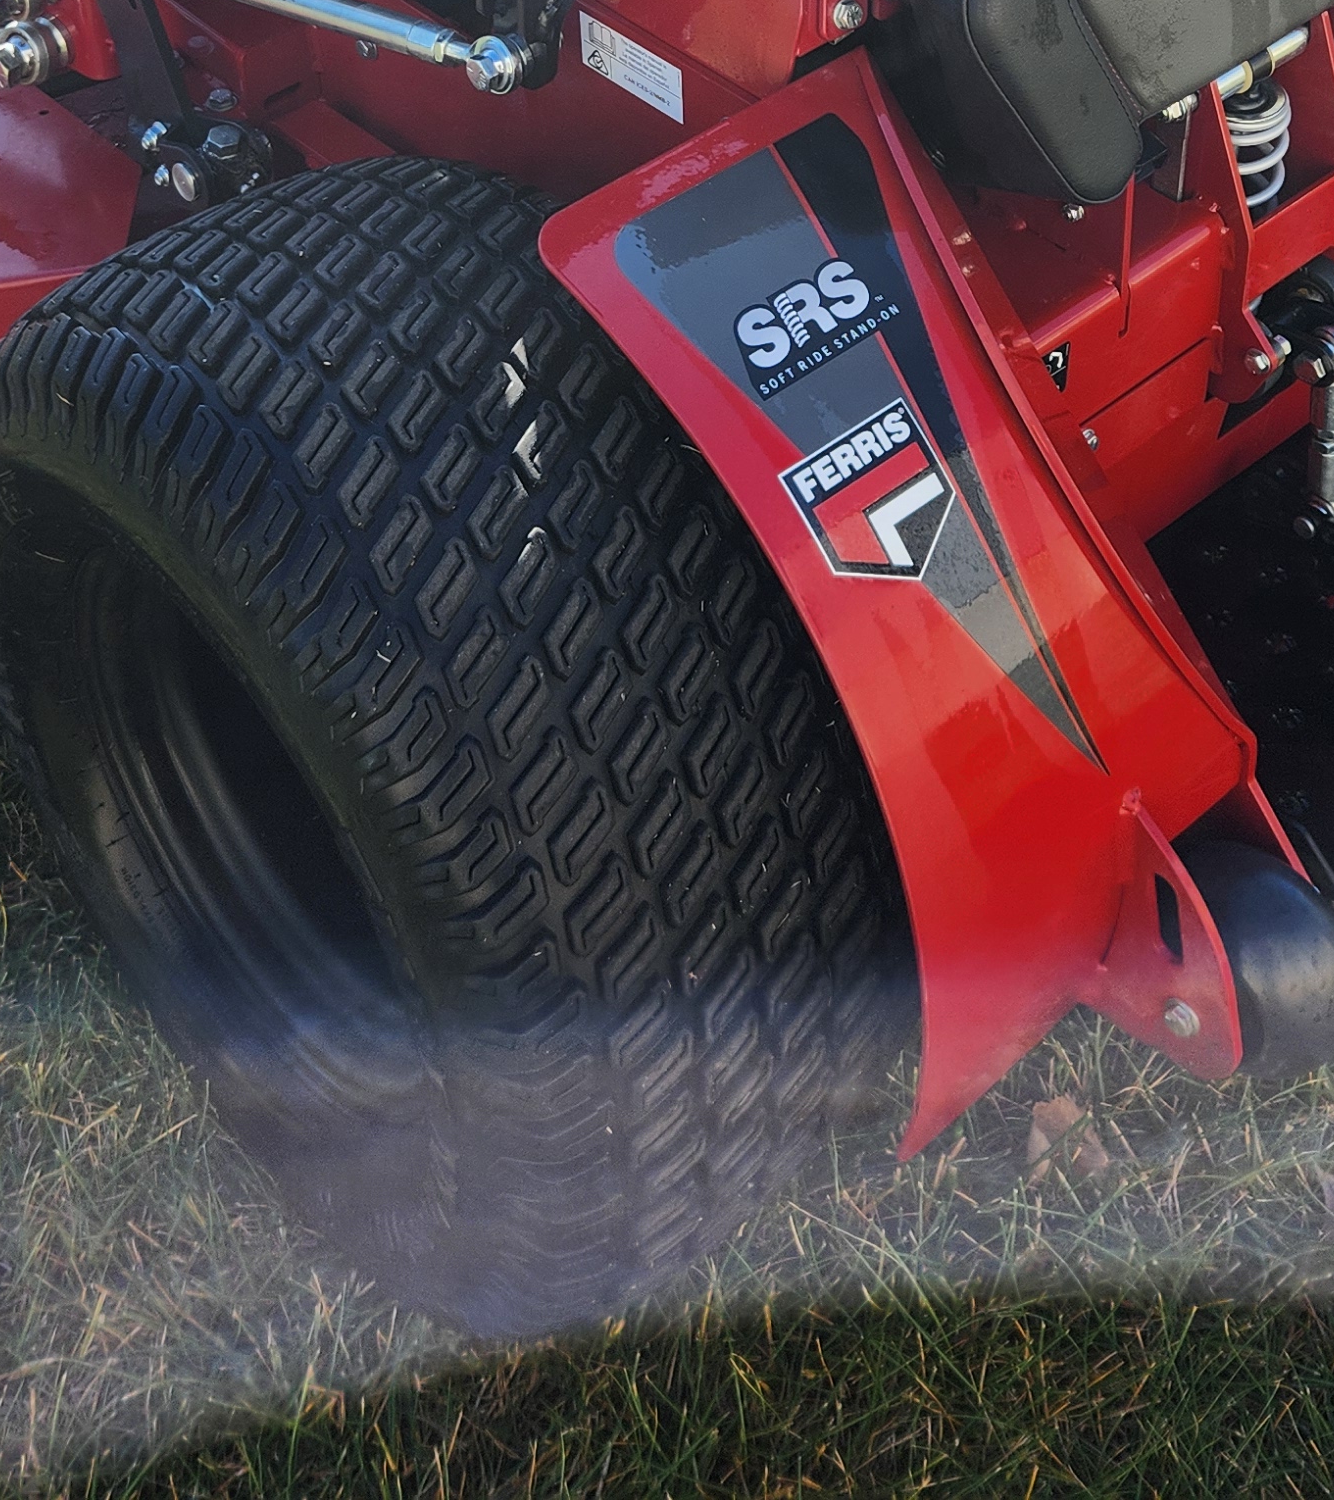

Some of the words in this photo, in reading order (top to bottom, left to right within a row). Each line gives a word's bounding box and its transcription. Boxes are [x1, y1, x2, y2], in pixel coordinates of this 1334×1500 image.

[737, 262, 869, 368] SRS
[759, 367, 795, 395] SOFT
[797, 345, 832, 372] RIDE
[834, 304, 900, 349] STAND-ON
[793, 412, 911, 503] FERRIS
